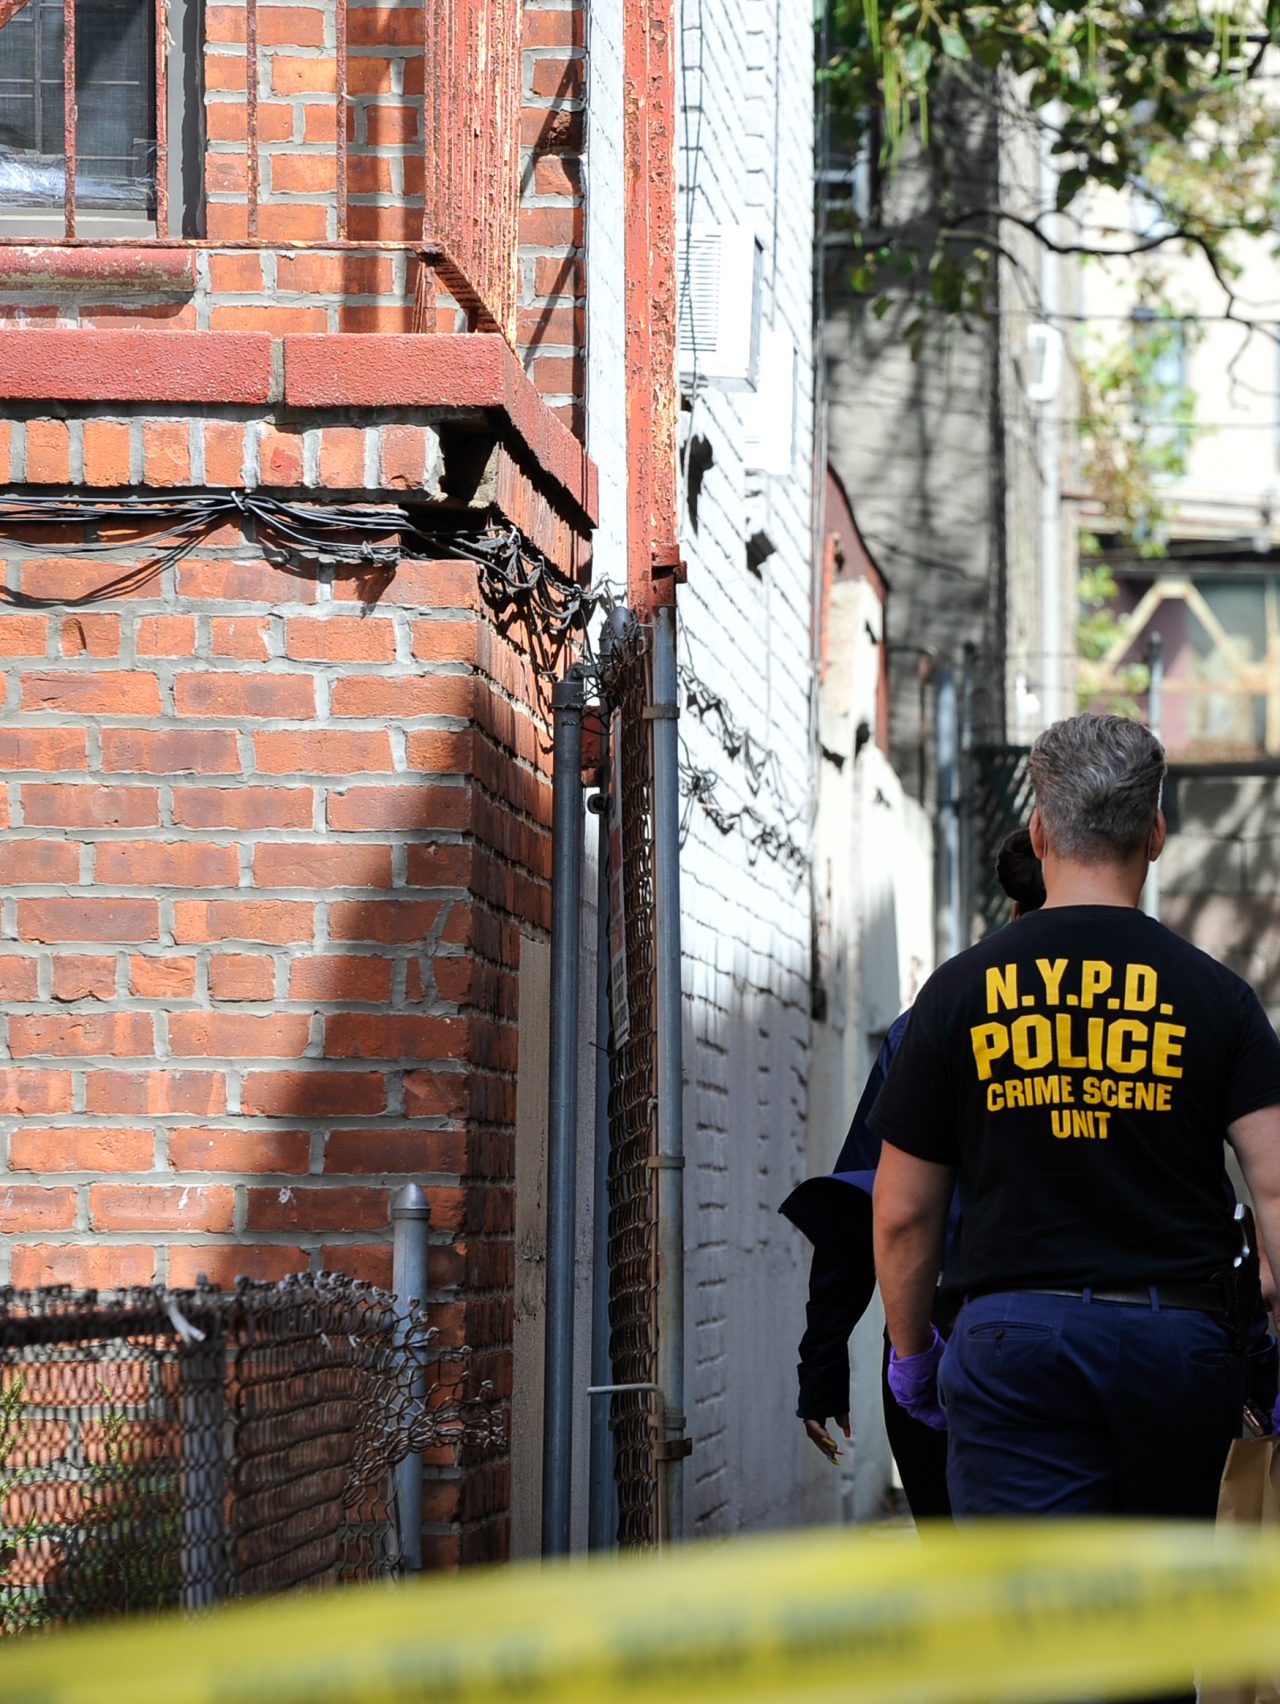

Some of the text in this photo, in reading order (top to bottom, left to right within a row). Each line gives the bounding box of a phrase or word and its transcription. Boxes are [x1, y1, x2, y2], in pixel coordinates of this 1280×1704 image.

[986, 959, 1174, 1014] N.Y.P.D.
[970, 1013, 1187, 1081] POLICE
[987, 1075, 1172, 1112] CRIME SCENE
[1051, 1110, 1111, 1139] UNIT
